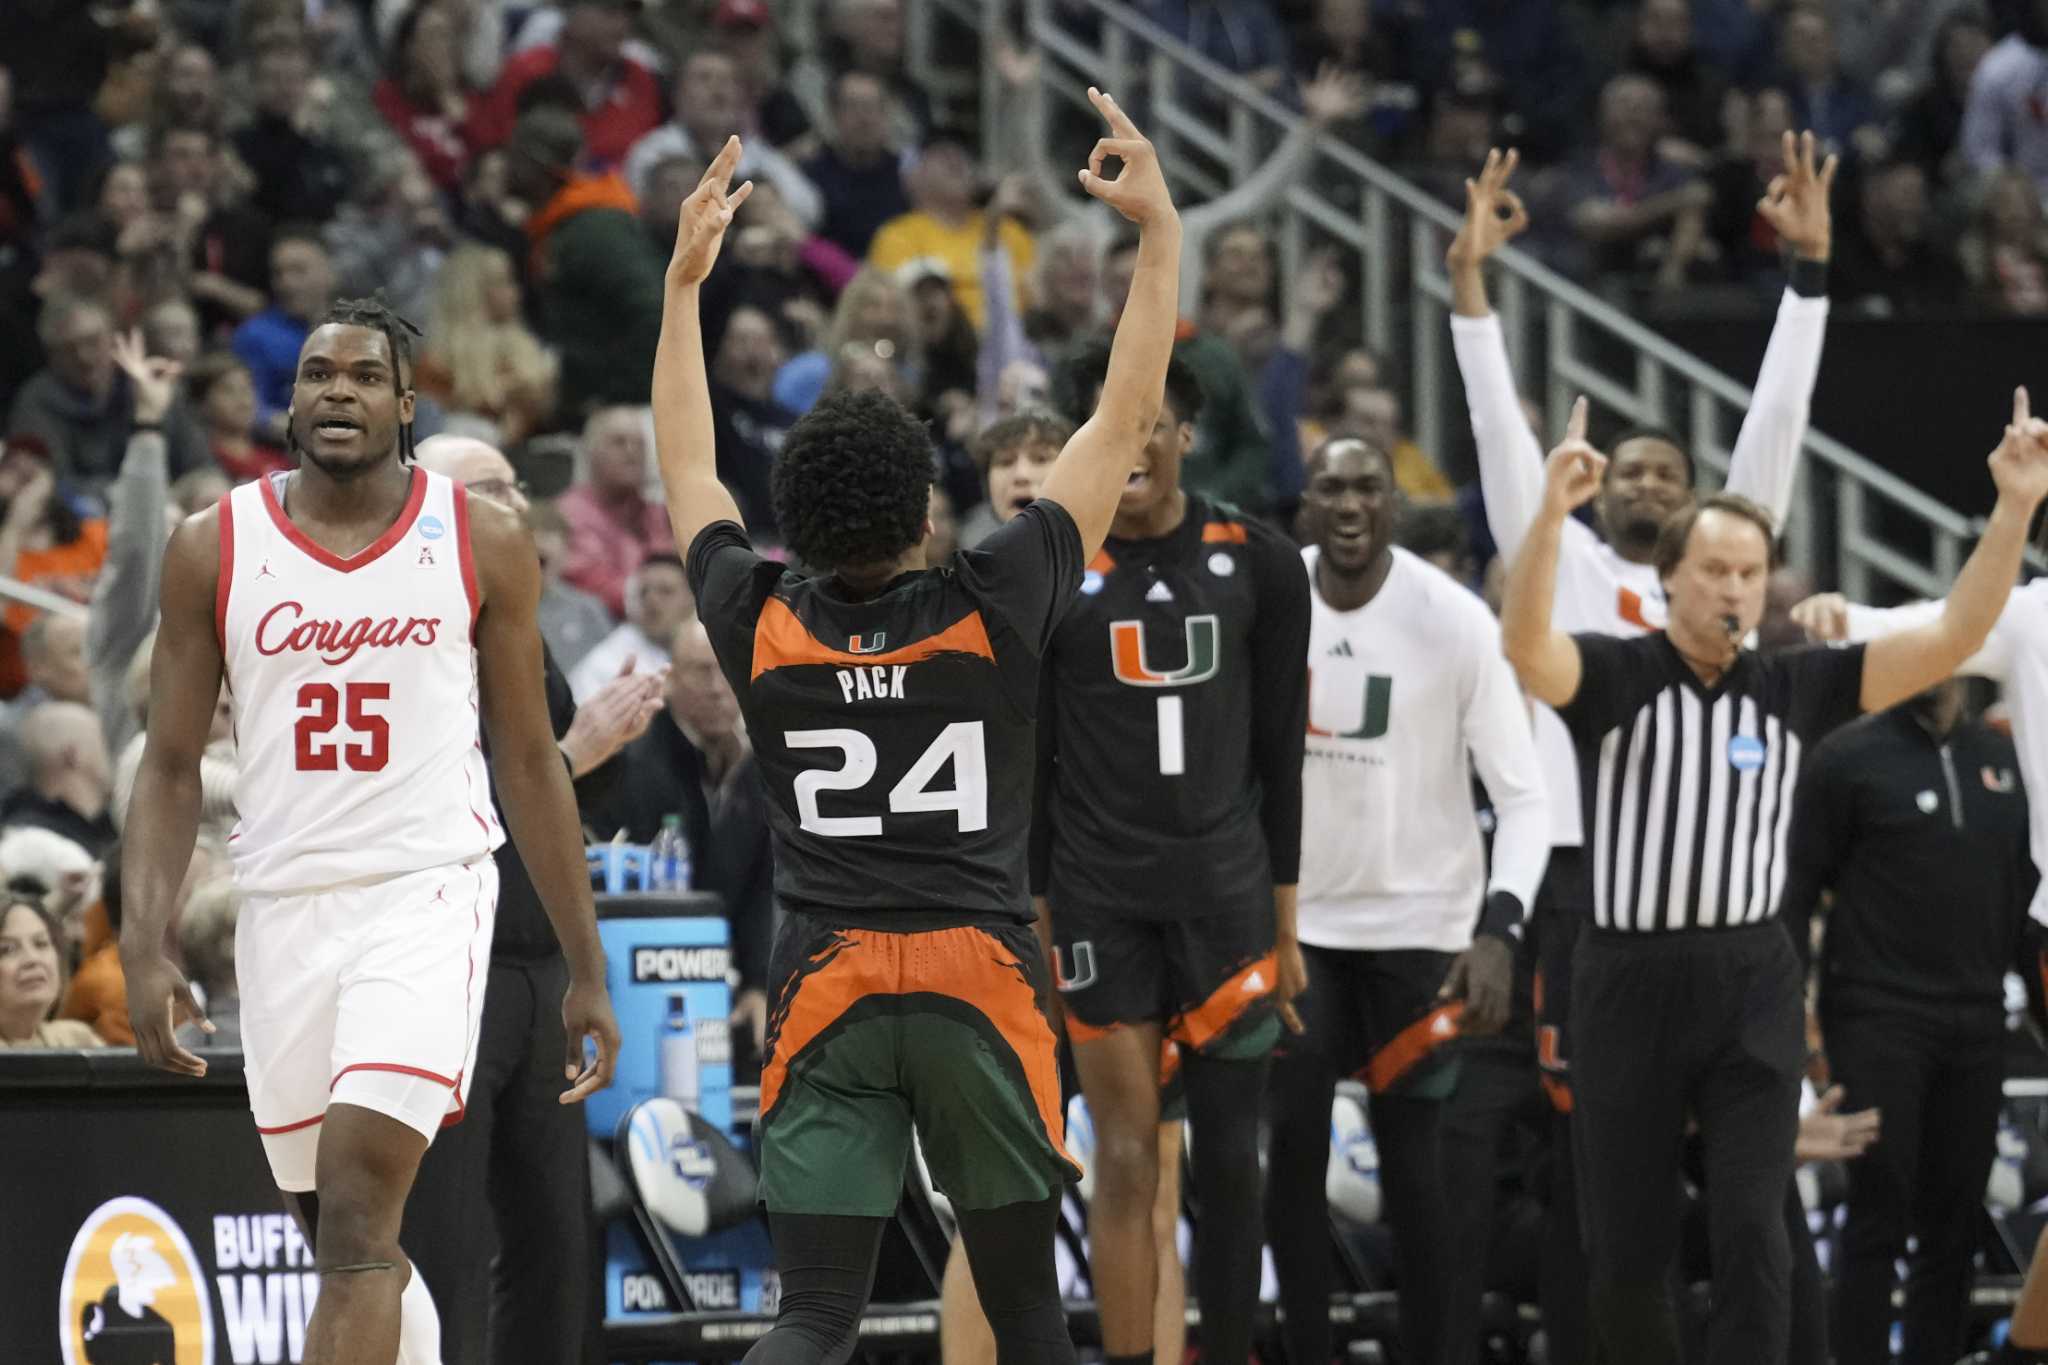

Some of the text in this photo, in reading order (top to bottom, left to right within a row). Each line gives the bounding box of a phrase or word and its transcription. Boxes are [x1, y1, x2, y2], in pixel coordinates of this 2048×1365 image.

[255, 601, 441, 666] Cougars
[1109, 615, 1221, 687] U
[836, 665, 908, 704] PACK
[294, 682, 390, 772] 25
[1156, 695, 1185, 775] 1
[784, 720, 988, 837] 24
